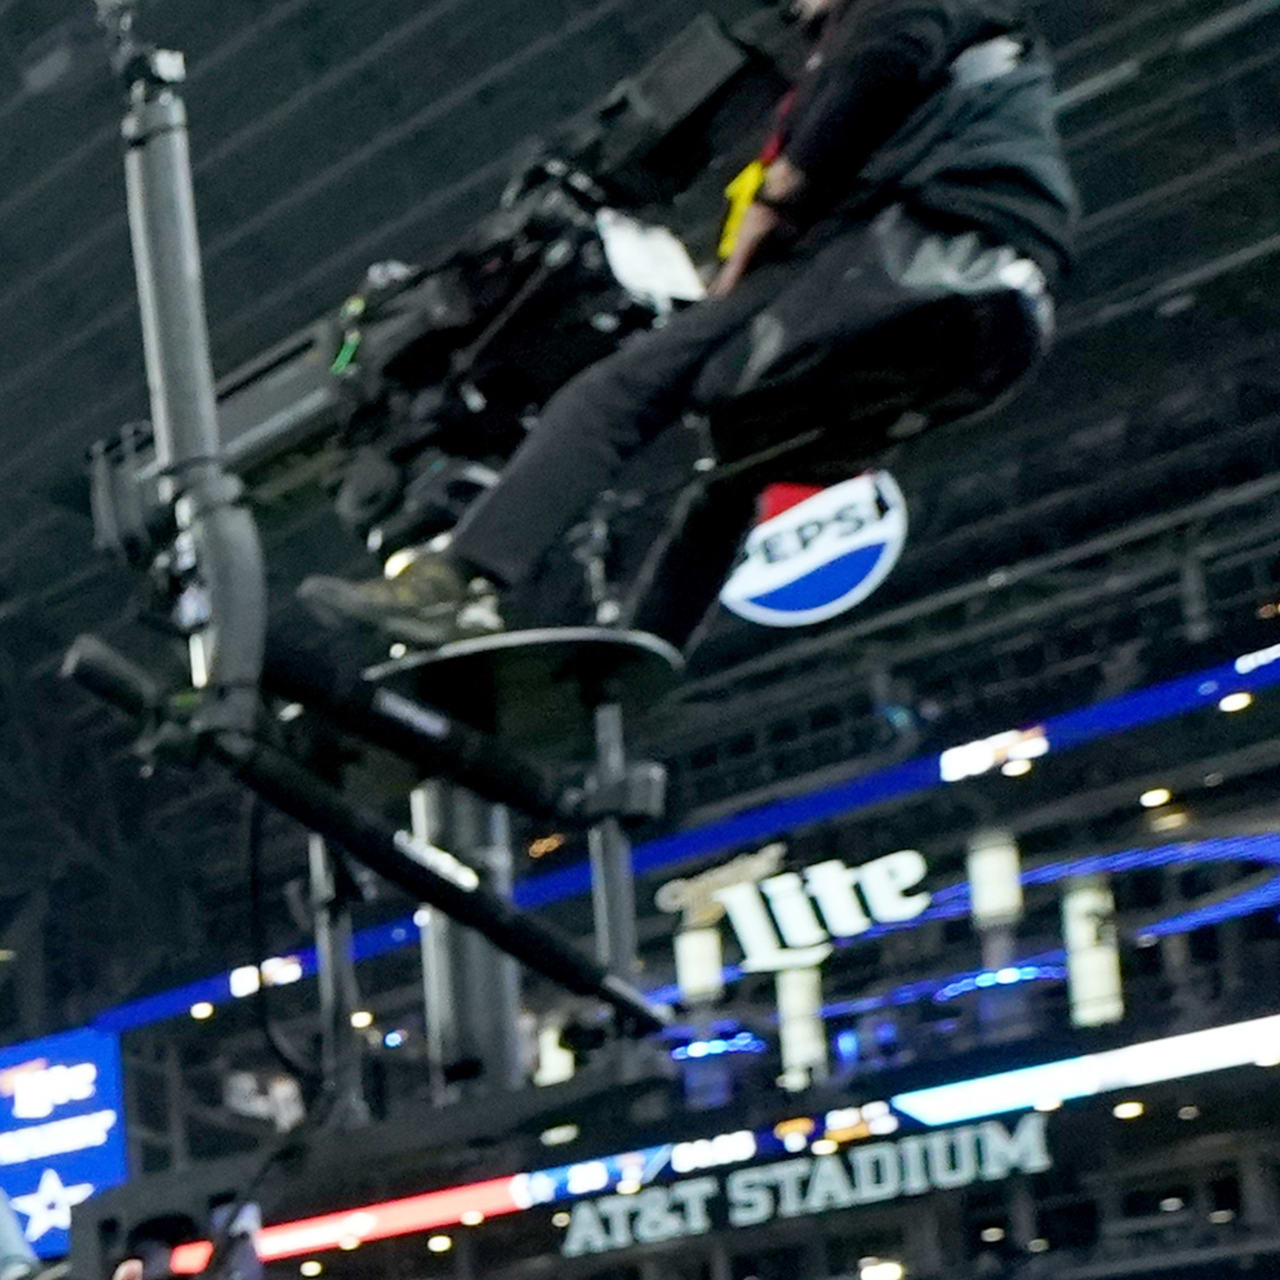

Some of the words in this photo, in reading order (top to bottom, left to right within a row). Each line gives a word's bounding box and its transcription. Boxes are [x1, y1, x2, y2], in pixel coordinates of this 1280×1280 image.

[743, 481, 892, 565] EPSI
[712, 849, 931, 973] Lite
[561, 1176, 720, 1258] AT&T
[727, 1112, 1054, 1226] STADIUM
